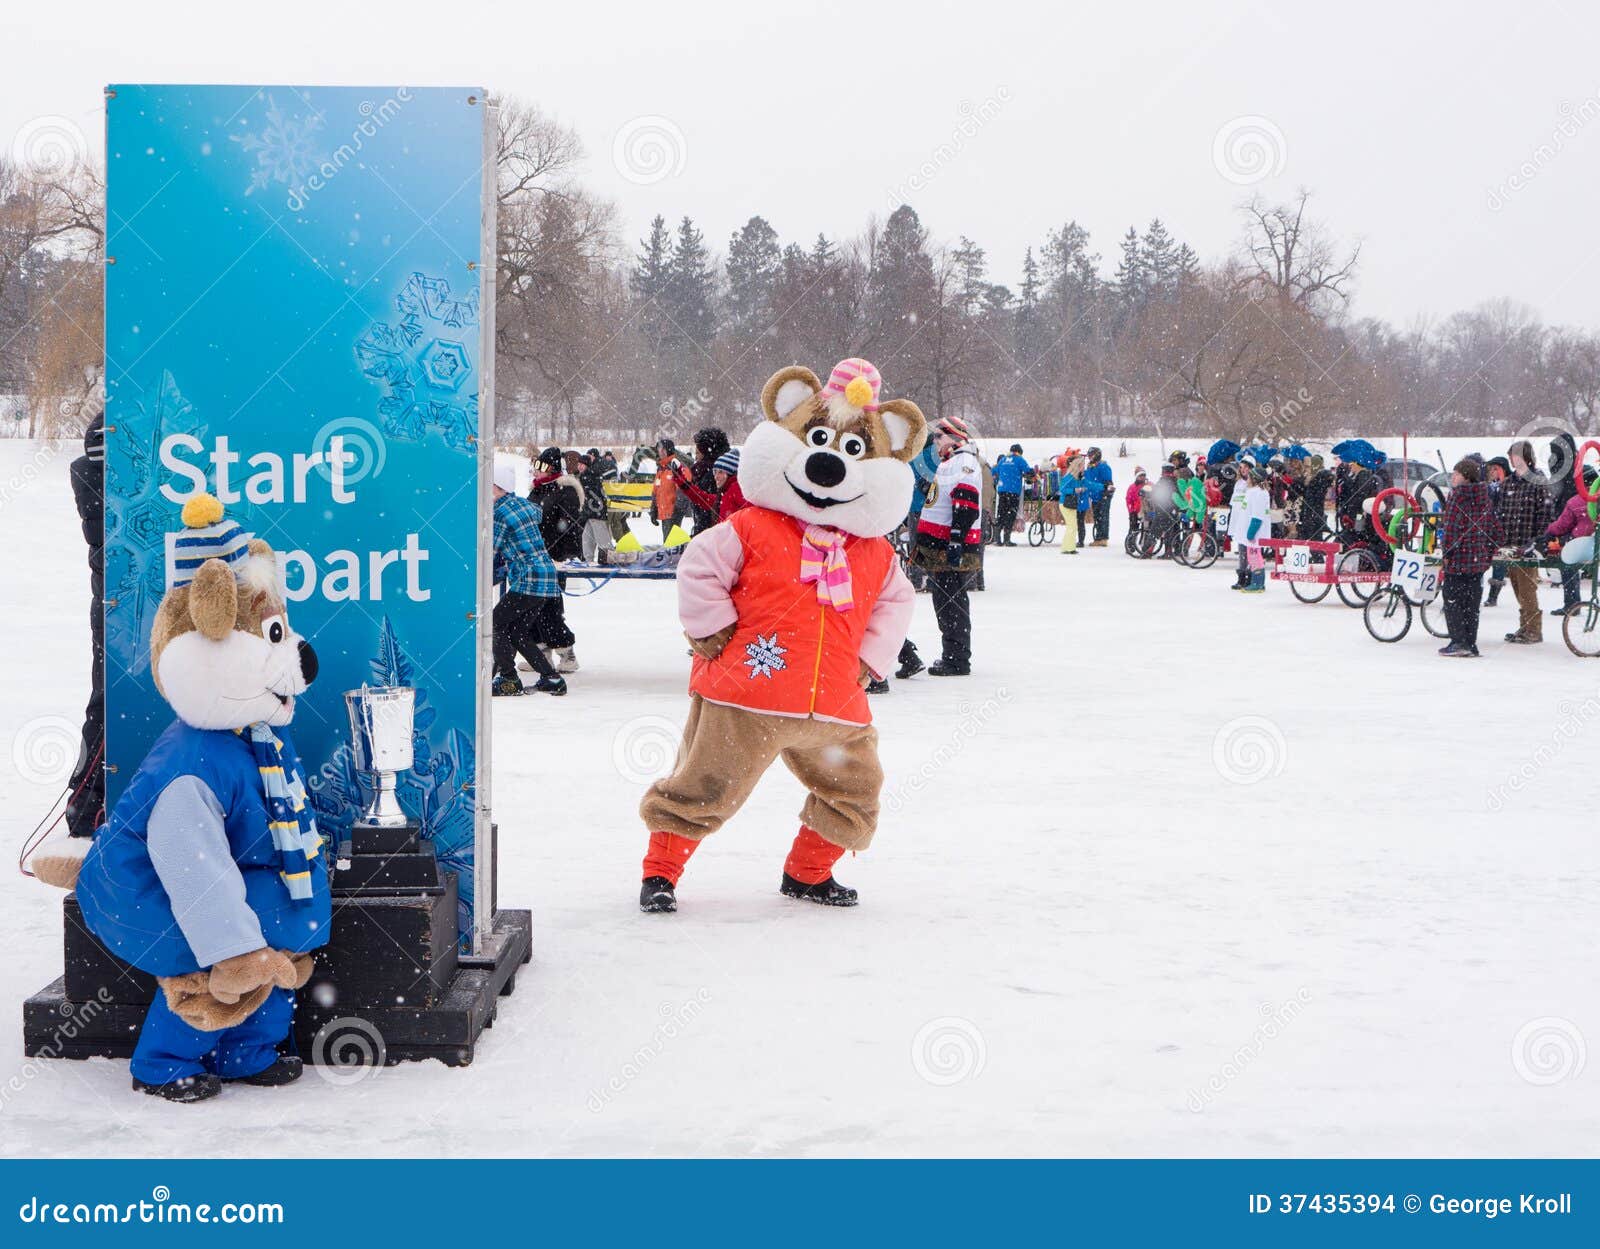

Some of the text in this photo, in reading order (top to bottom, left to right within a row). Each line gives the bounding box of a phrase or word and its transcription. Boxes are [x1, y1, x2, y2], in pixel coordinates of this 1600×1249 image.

[159, 433, 356, 505] Start
[165, 532, 432, 606] part
[1293, 552, 1307, 567] 30
[1397, 558, 1420, 580] 72
